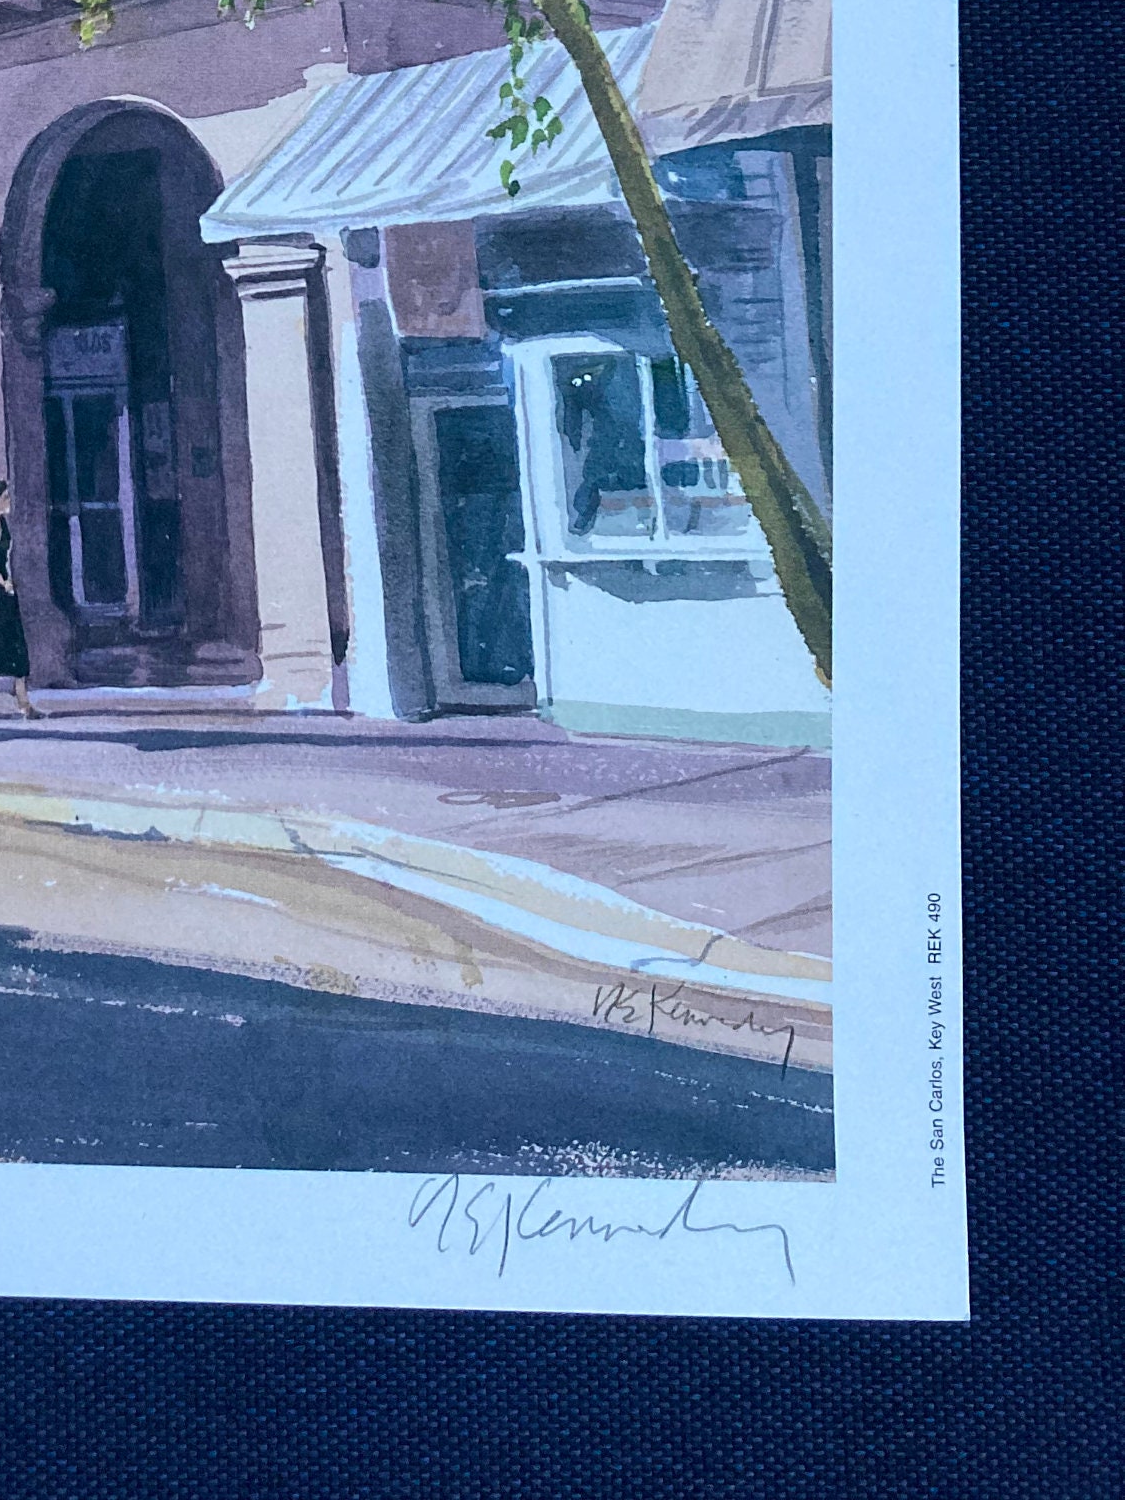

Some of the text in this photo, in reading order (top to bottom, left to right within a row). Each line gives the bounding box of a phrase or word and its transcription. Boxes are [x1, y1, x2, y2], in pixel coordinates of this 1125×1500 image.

[927, 893, 946, 1188] The San Carlos, Key West REK 490
